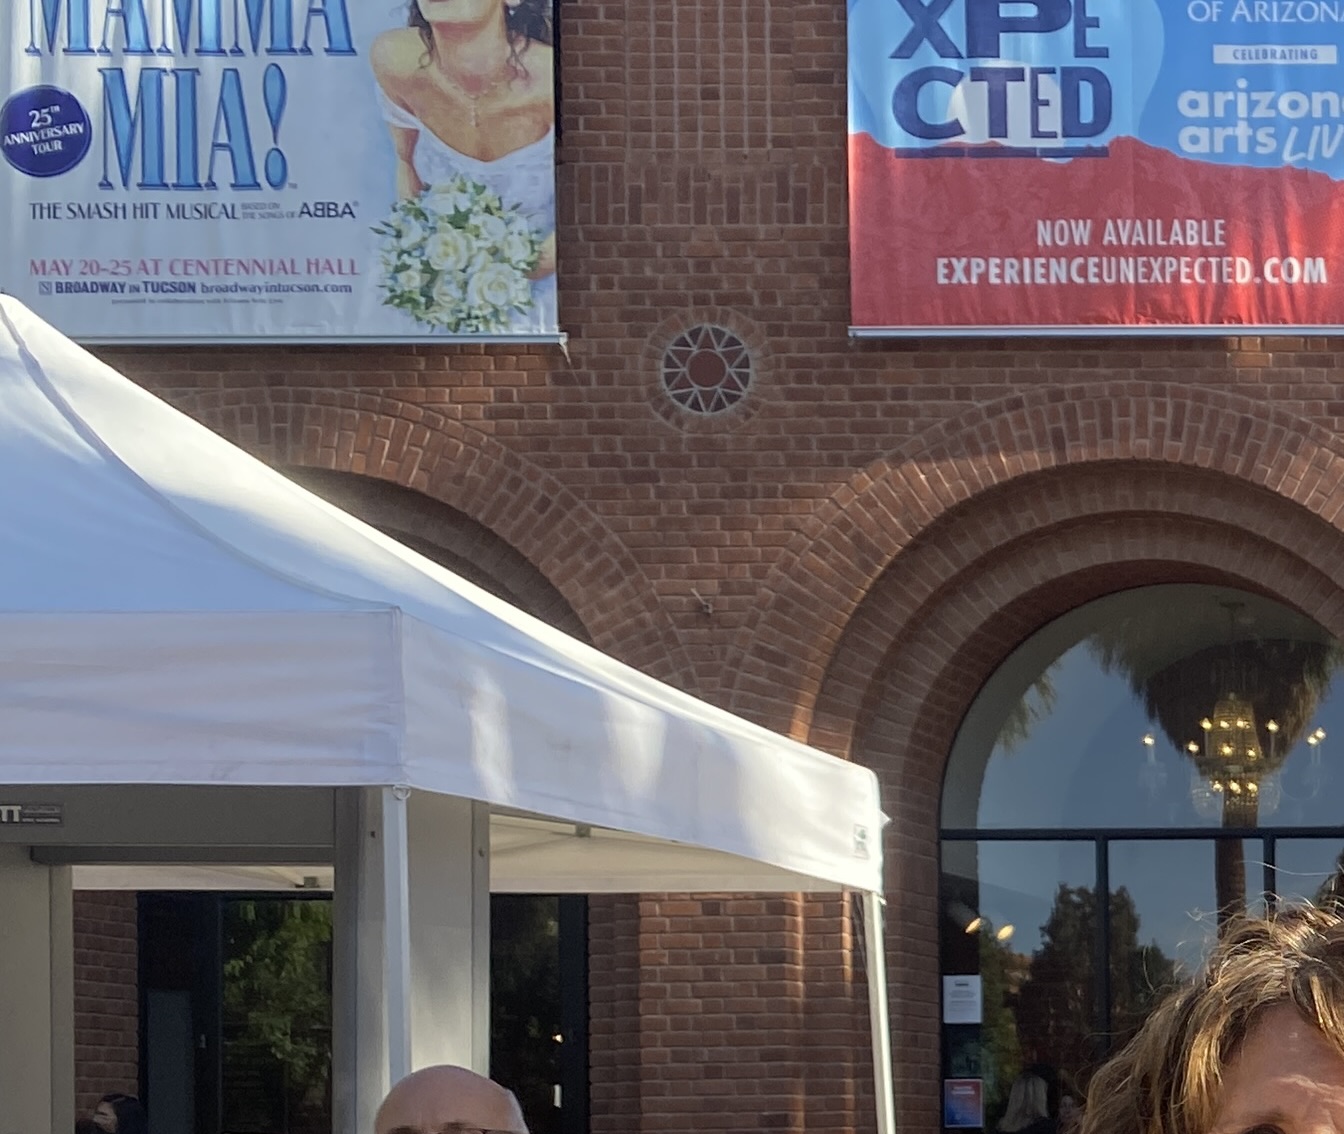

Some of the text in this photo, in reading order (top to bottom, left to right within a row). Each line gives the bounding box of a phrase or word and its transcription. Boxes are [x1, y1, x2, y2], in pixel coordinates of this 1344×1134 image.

[1187, 1, 1224, 22] OF
[1232, 49, 1319, 60] CELEBRATING
[892, 66, 1113, 140] CTED
[29, 105, 60, 128] 25TH
[98, 63, 288, 191] MIA!
[4, 122, 85, 146] ANNIVERSARY
[1178, 120, 1277, 154] arts
[31, 140, 63, 155] TOUR
[30, 202, 240, 220] THE SMASH HIT MUSICAL
[1036, 219, 1225, 246] NOW AVAILABLE
[29, 258, 360, 276] MAY 20-25 AT CENTENNIAL HALL
[936, 256, 1327, 285] EXPERIENCEUNEXPECTED.COM
[55, 281, 352, 296] BROADWAY IN TUCSON broadwayintucson.com
